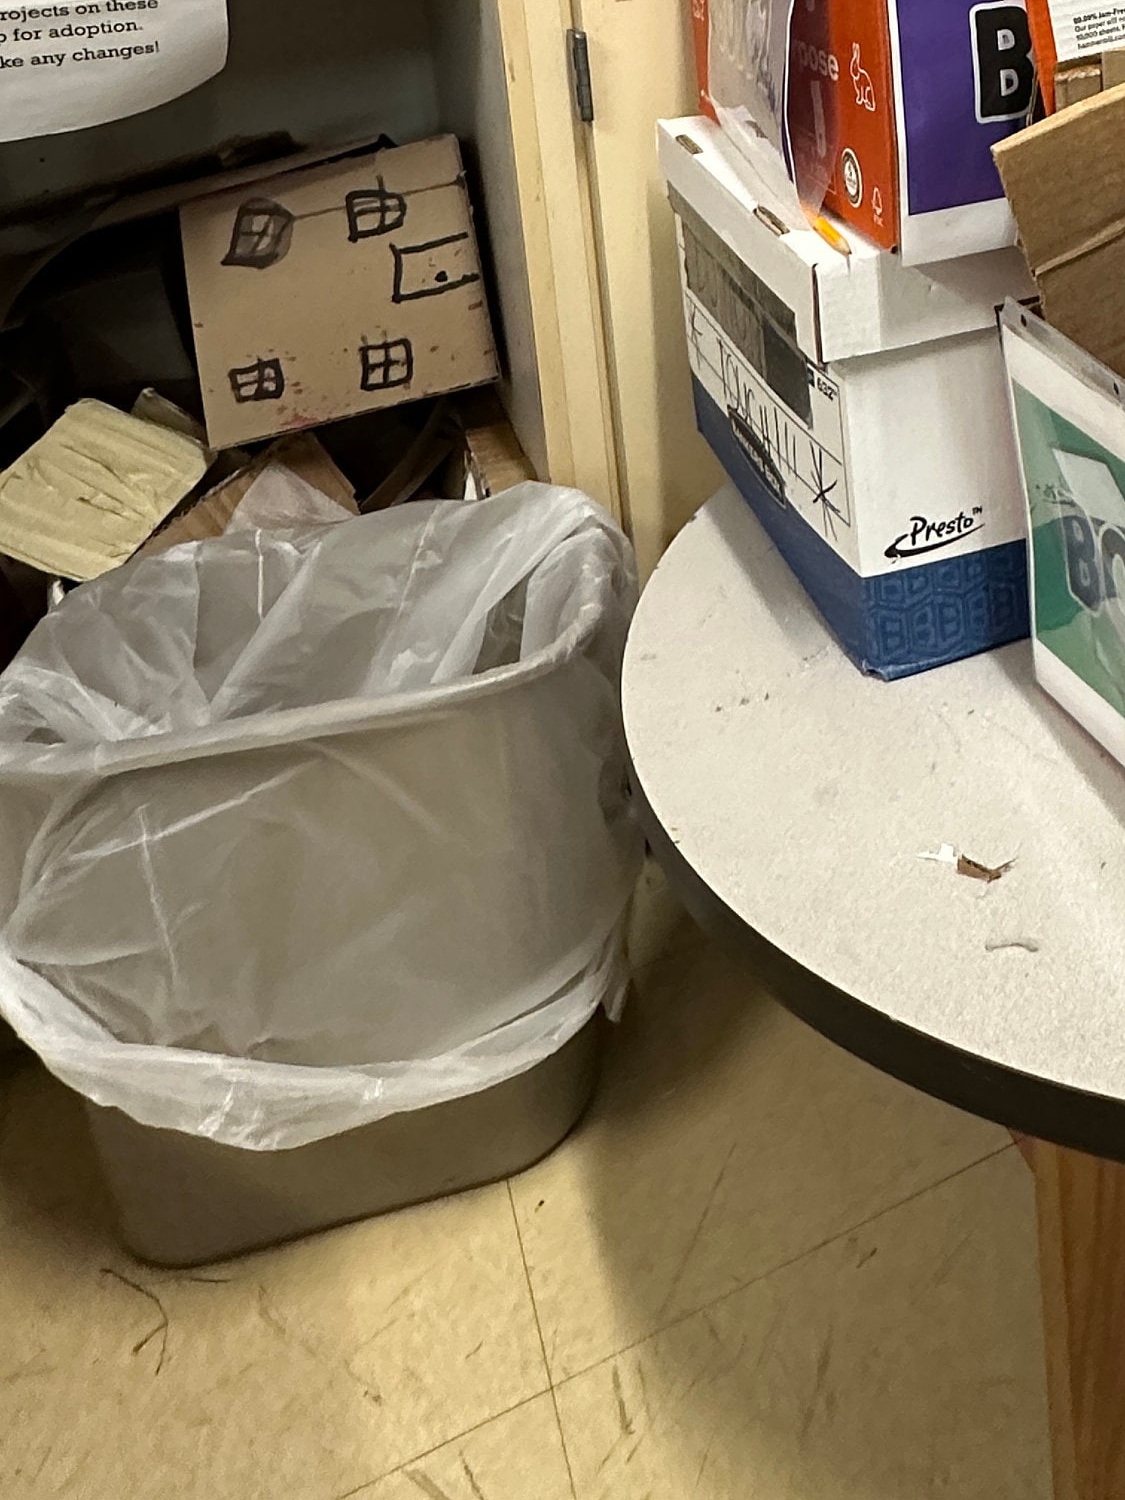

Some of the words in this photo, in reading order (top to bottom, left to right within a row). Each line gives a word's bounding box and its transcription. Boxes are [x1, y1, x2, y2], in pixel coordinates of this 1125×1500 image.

[75, 3, 101, 16] on
[13, 28, 42, 41] for
[48, 19, 144, 41] adoption.
[30, 52, 66, 67] any
[72, 41, 160, 62] changes!
